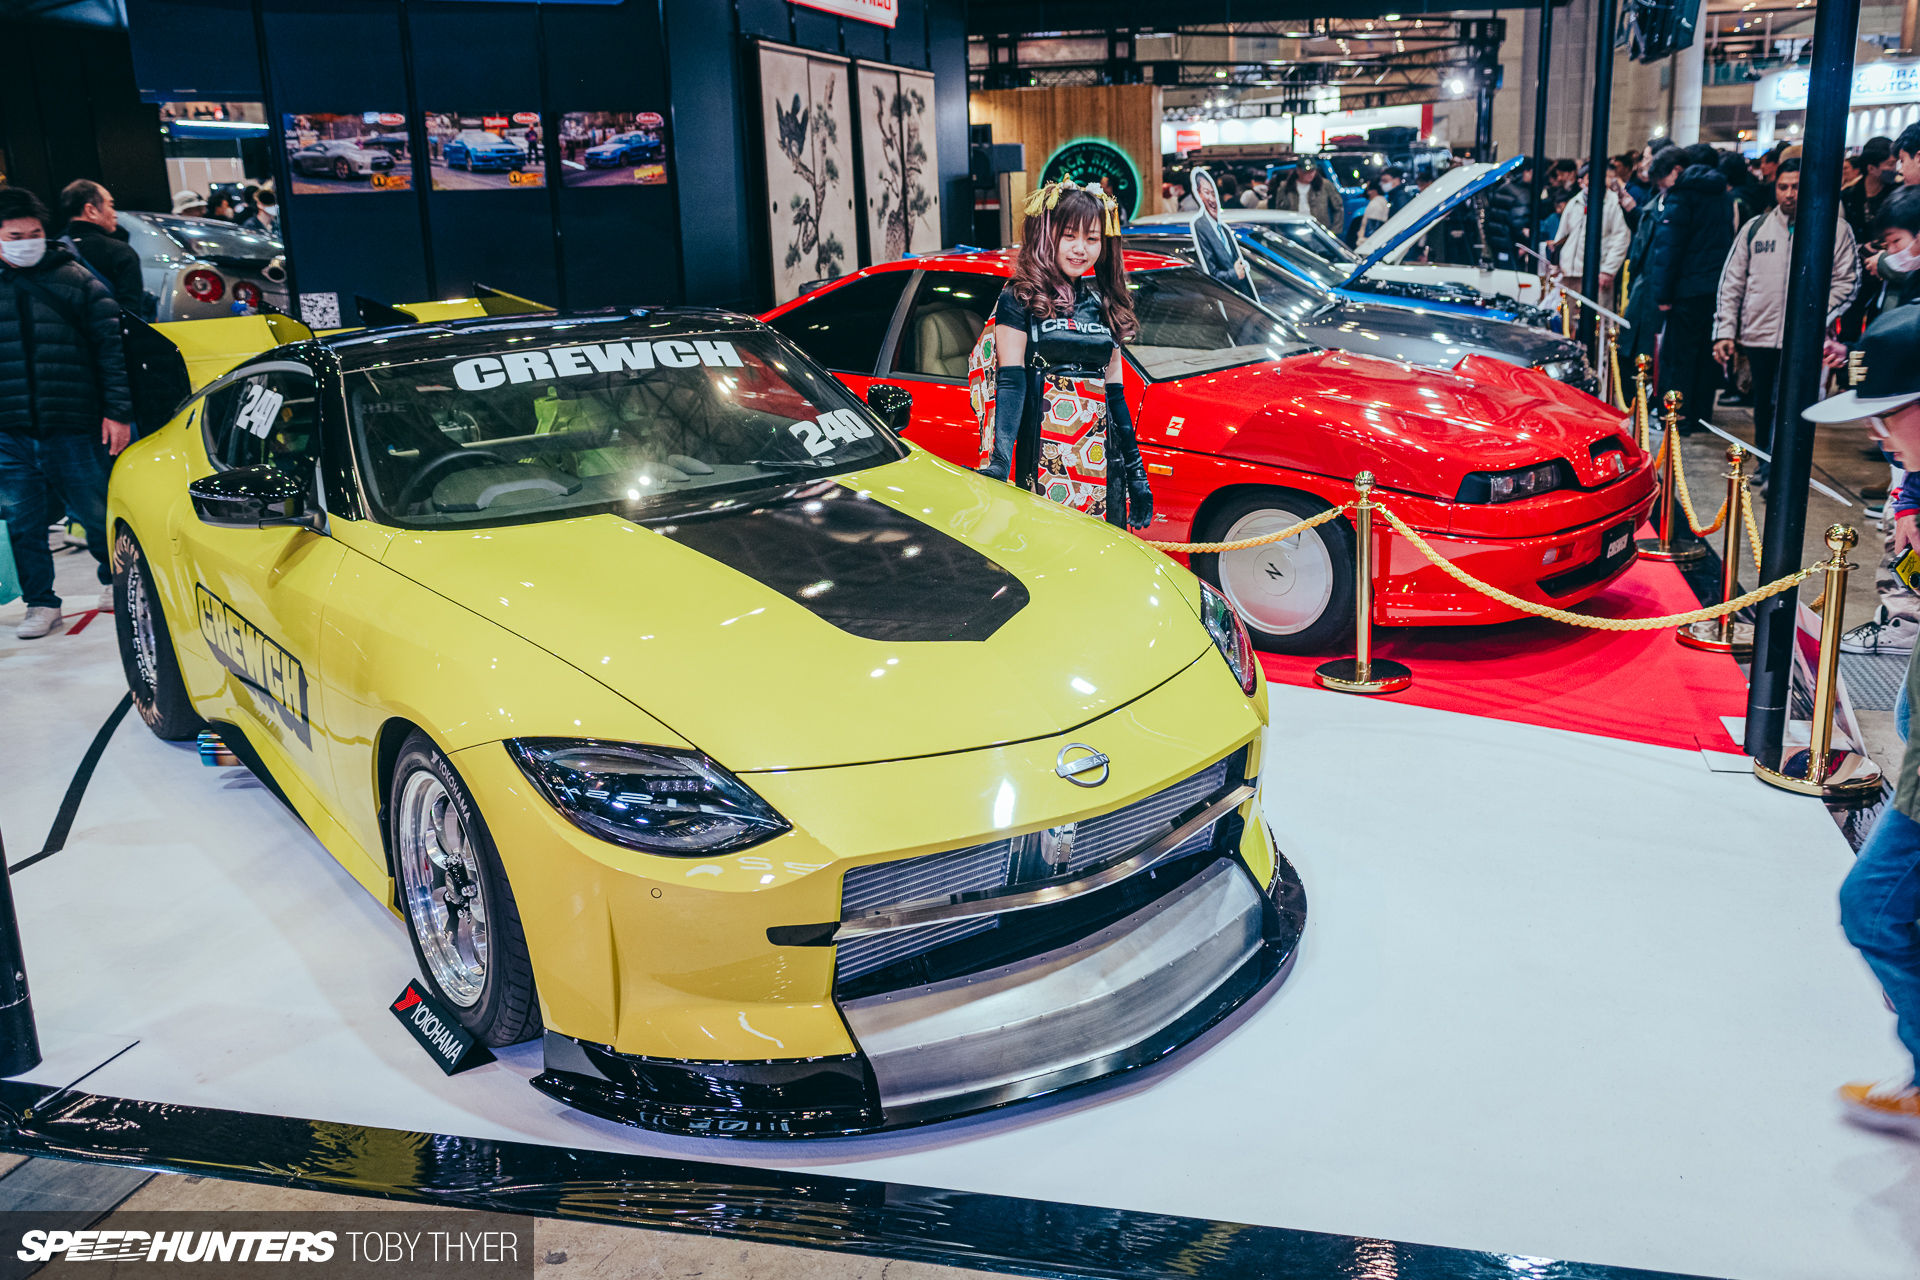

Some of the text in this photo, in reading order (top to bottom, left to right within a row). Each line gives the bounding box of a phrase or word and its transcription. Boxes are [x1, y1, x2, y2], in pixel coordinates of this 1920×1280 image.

[1041, 318, 1112, 336] CREWCH
[452, 340, 745, 392] CREWCH
[235, 384, 284, 440] 240
[361, 402, 407, 414] RIDE
[788, 408, 875, 457] 240
[196, 584, 306, 727] CREWCH
[438, 758, 471, 824] YOKOHAMA
[1058, 754, 1109, 777] NISSAN
[410, 1000, 464, 1065] YOKOHAMA
